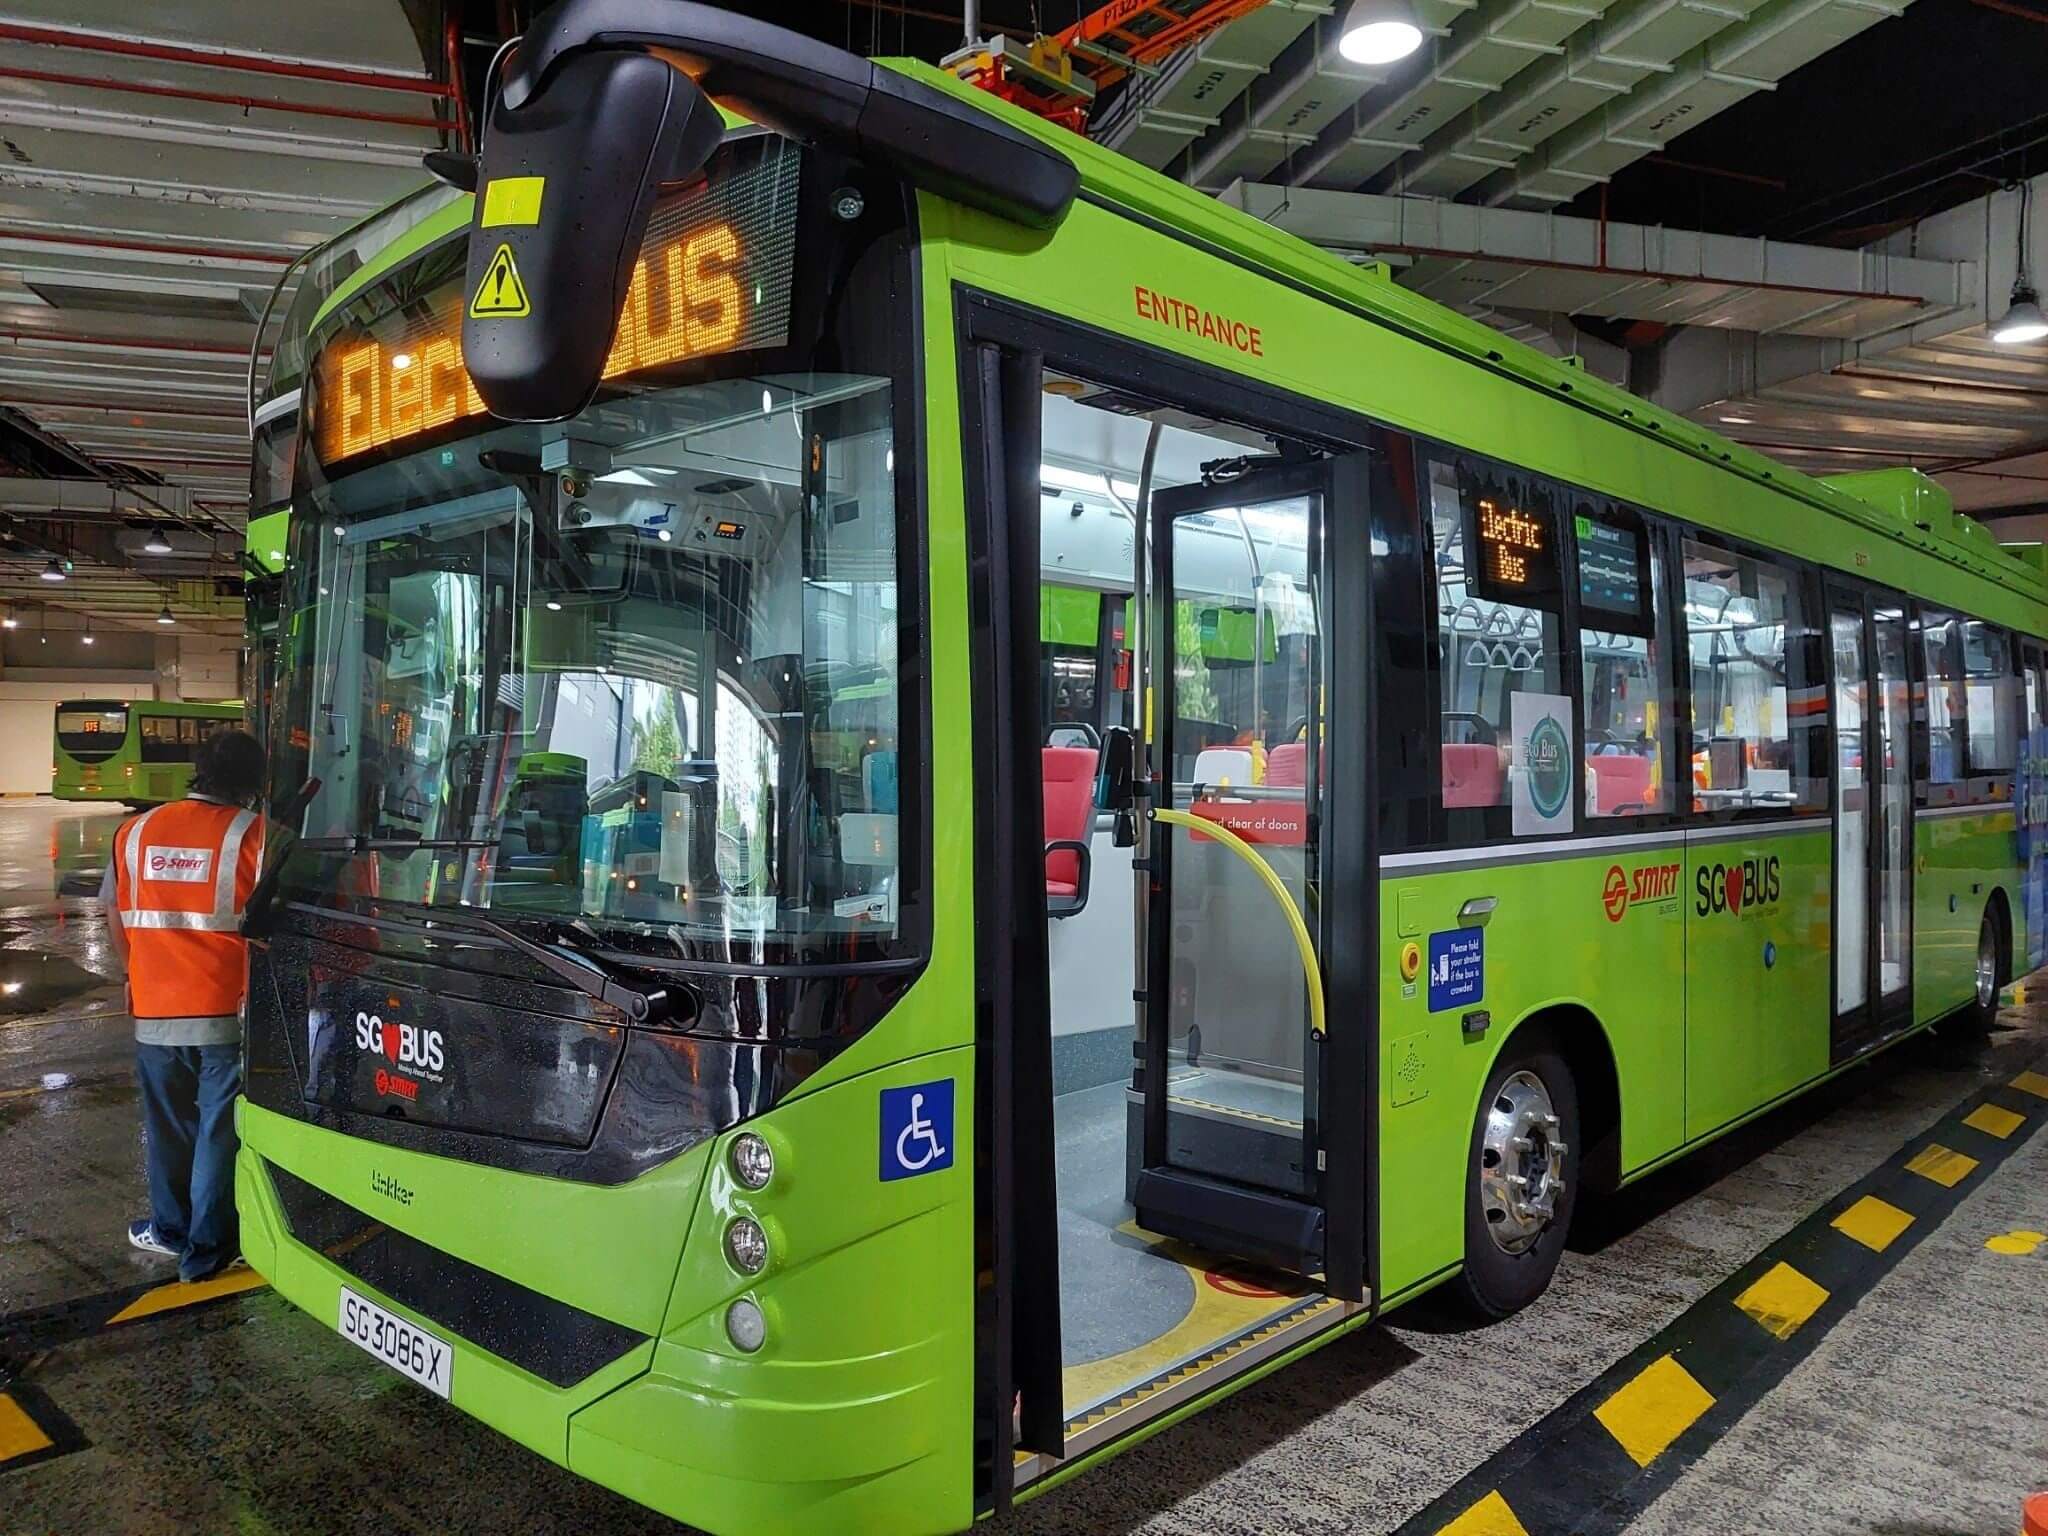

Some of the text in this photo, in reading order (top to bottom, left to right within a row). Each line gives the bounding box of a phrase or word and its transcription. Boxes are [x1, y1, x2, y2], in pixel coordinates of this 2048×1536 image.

[1135, 285, 1264, 357] ENTRANCE
[1227, 817, 1252, 830] clear
[1254, 817, 1266, 830] of
[1267, 817, 1298, 831] doors
[167, 857, 206, 869] SMRT
[1629, 863, 1681, 902] SMRT
[1450, 938, 1479, 954] Please fold
[1450, 951, 1481, 971] your stroller
[1455, 969, 1464, 981] the
[1450, 980, 1473, 996] crowded
